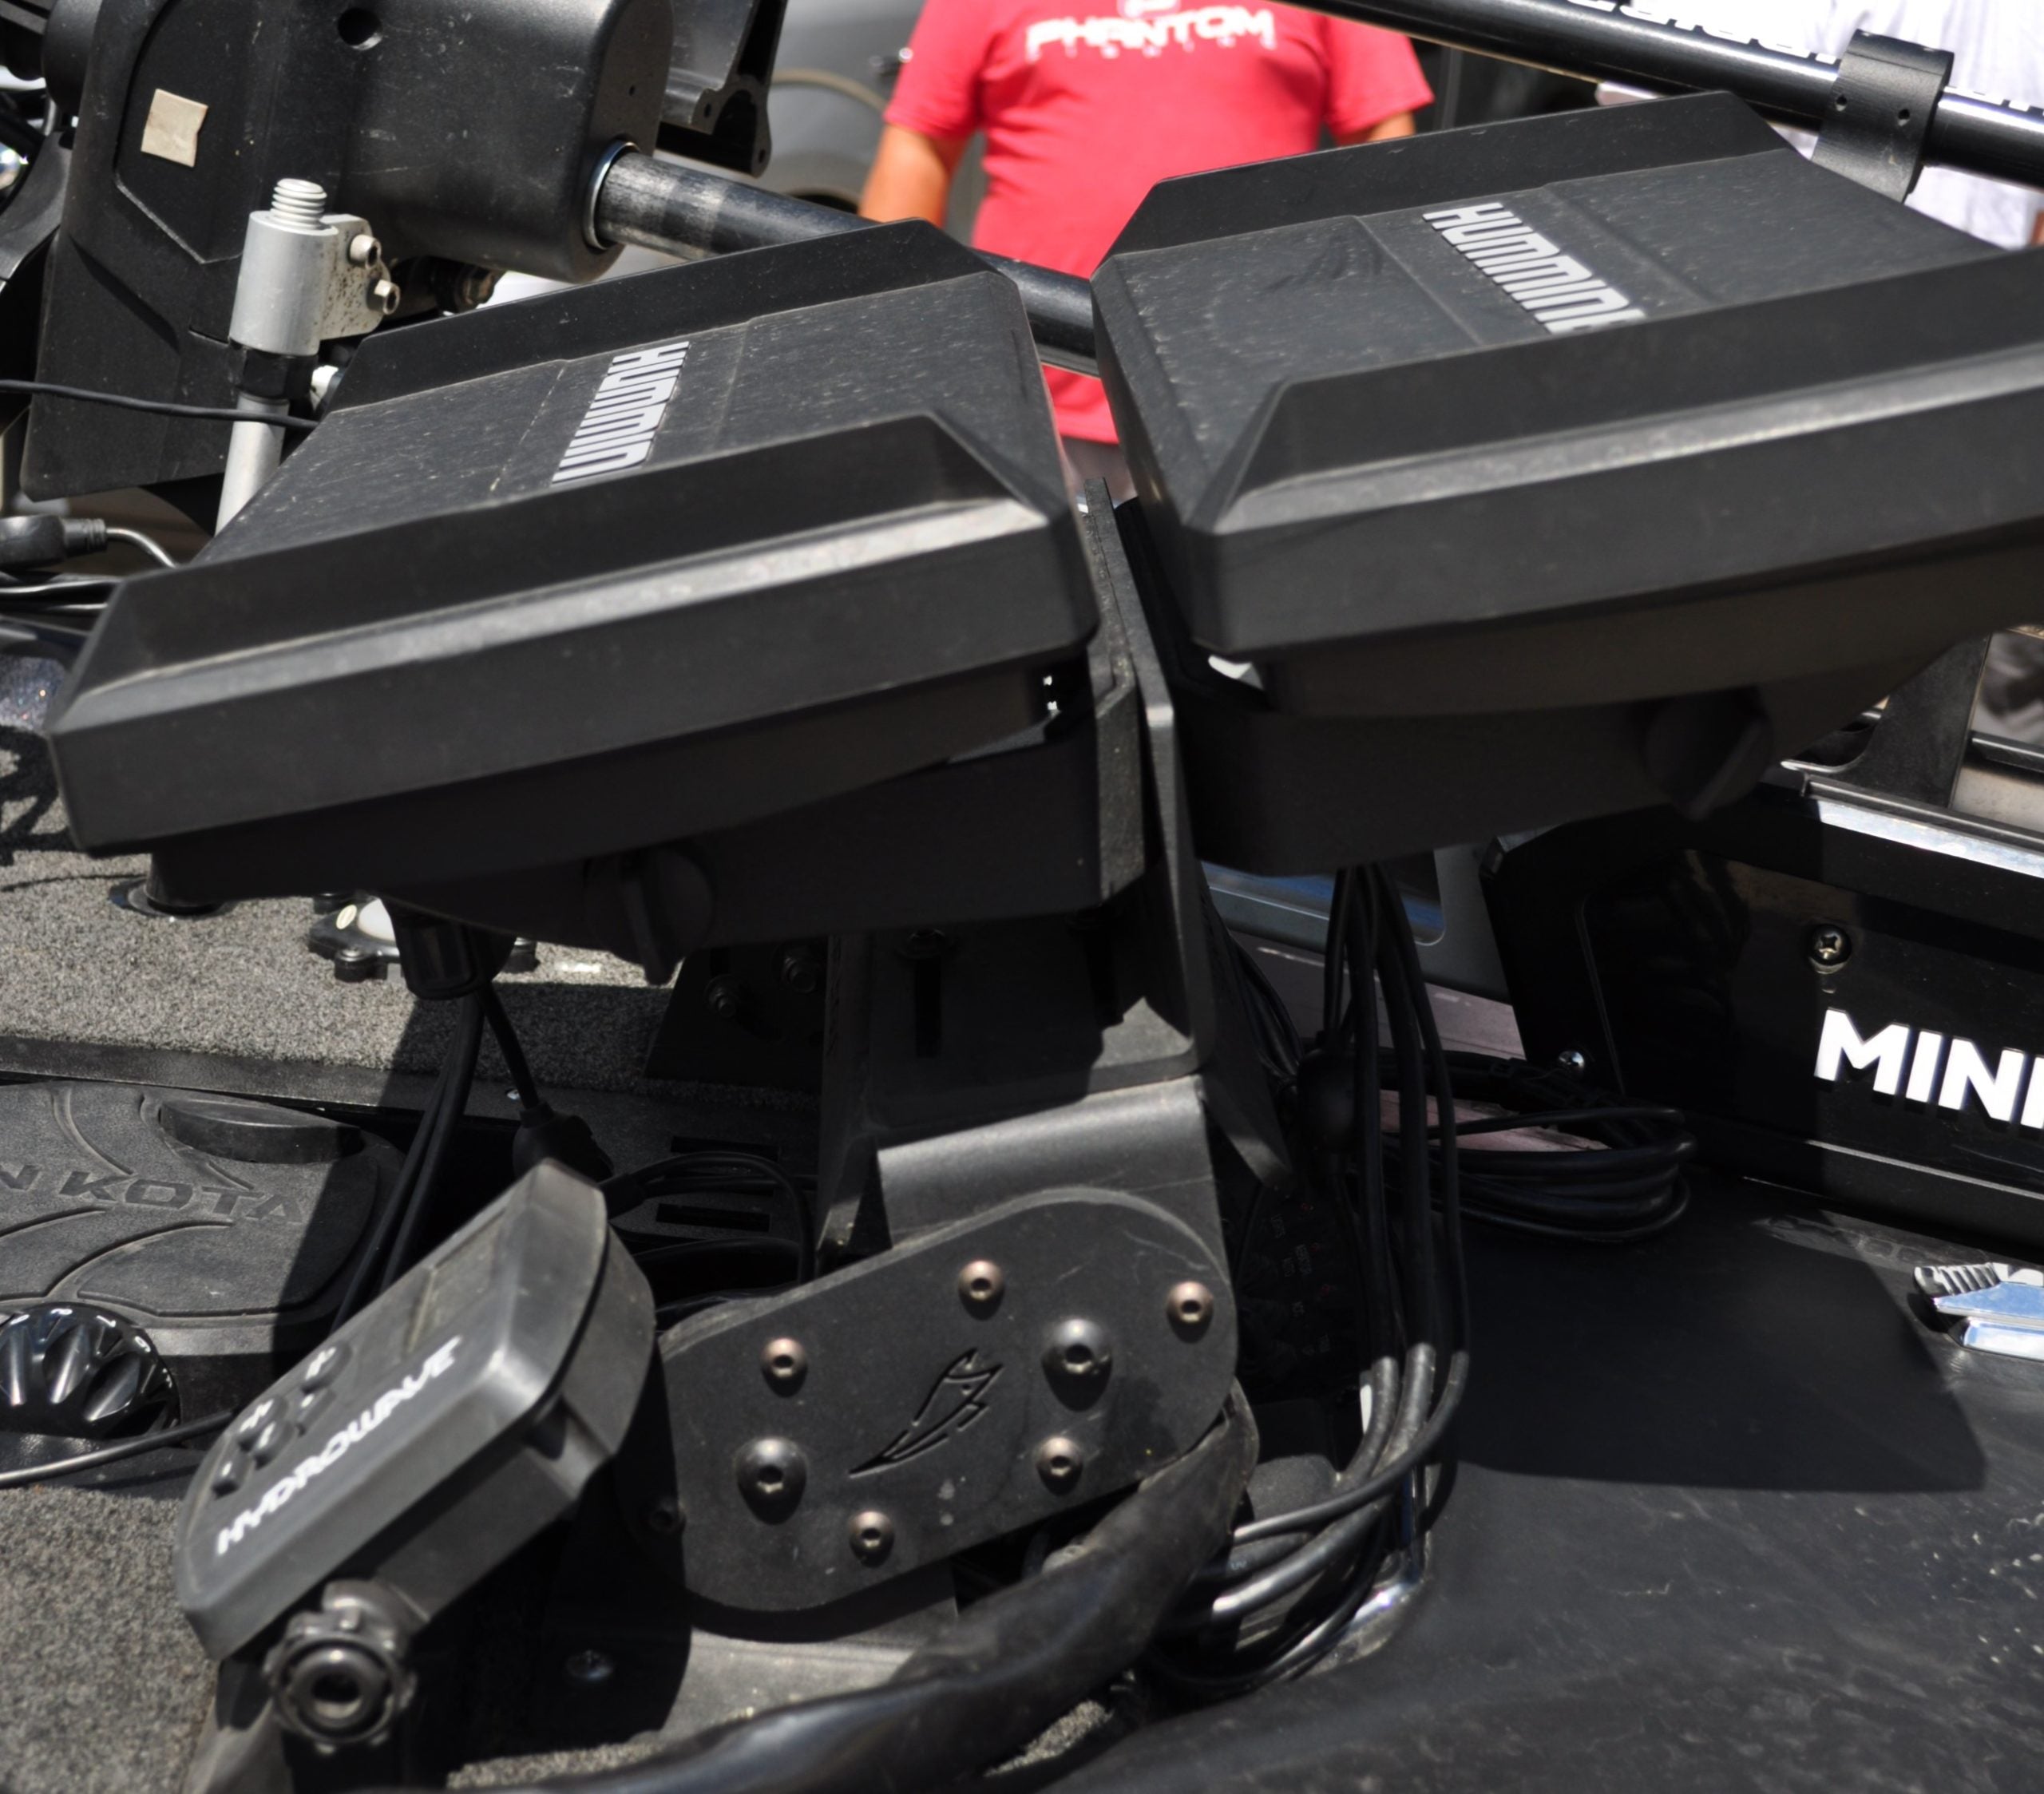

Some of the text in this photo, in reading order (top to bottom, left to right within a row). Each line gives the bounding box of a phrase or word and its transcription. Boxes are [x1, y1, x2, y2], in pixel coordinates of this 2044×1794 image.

[1026, 6, 1276, 62] PHANTOM
[59, 1170, 303, 1224] KOTA
[216, 1335, 461, 1555] HYDROWAVE
